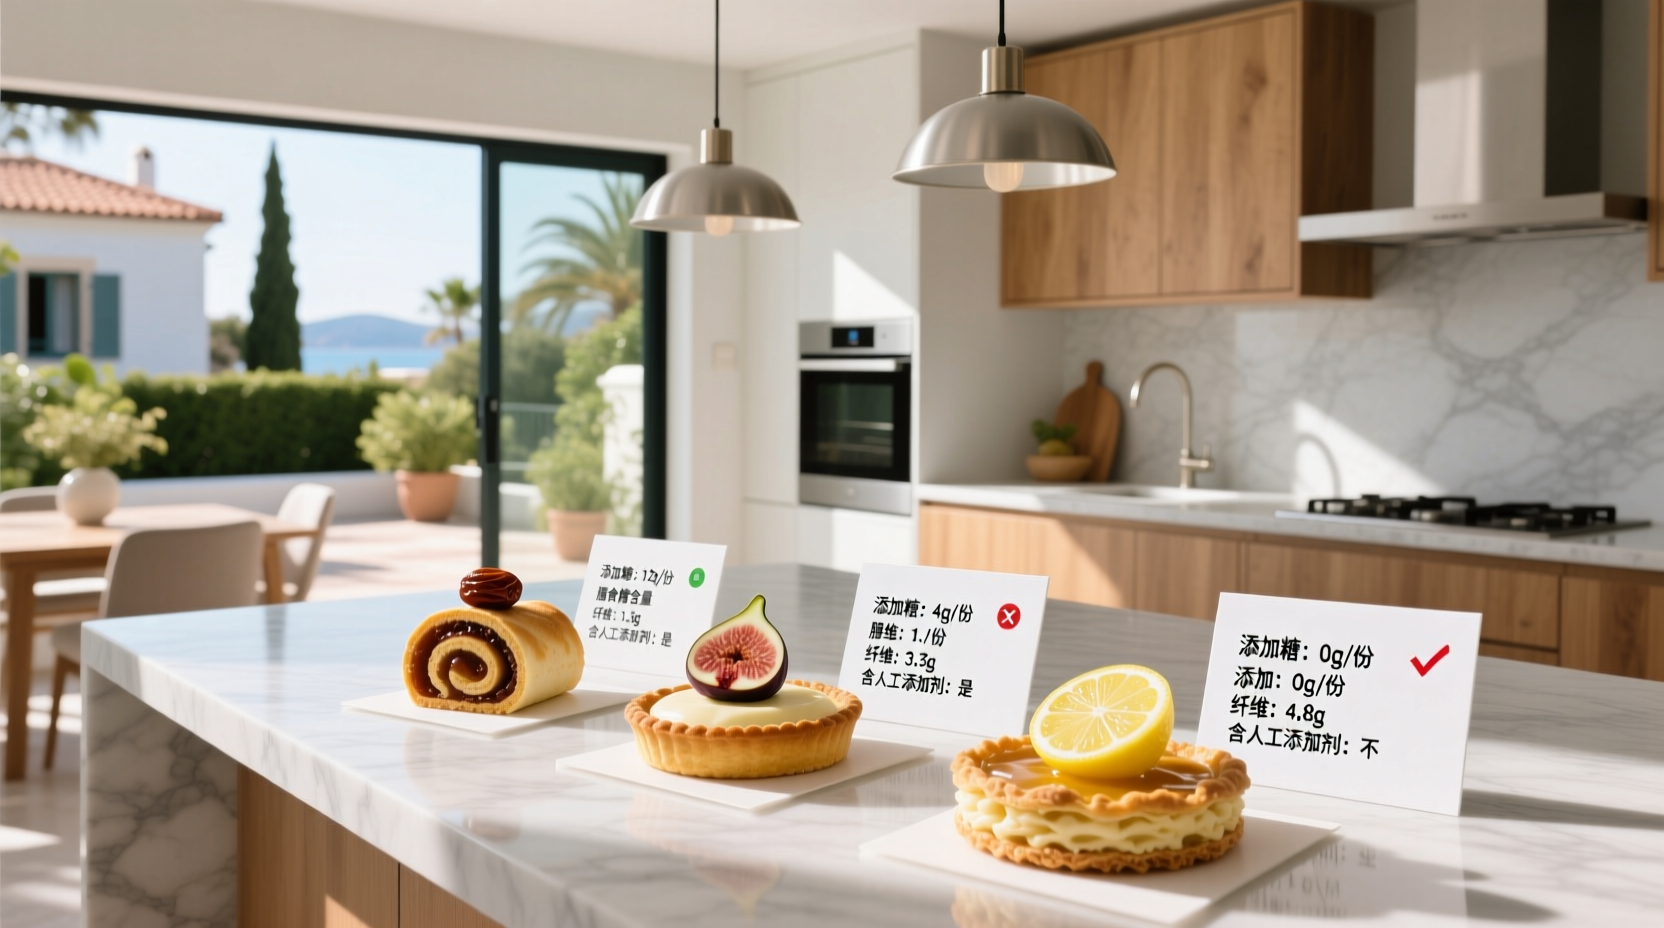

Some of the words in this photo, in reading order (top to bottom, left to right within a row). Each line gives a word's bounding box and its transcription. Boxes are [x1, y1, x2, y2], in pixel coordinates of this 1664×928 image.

[873, 596, 974, 624] 添加糖：4g/份
[864, 644, 937, 673] 纤维：3.3g
[1238, 633, 1375, 670] 添加糖：0g/份
[861, 667, 974, 698] 含人工添加剂：是
[1233, 665, 1346, 697] 添加：0g/份
[1229, 693, 1326, 729] 纤维：4.8g
[1228, 721, 1380, 760] 含人工添加剂：不
